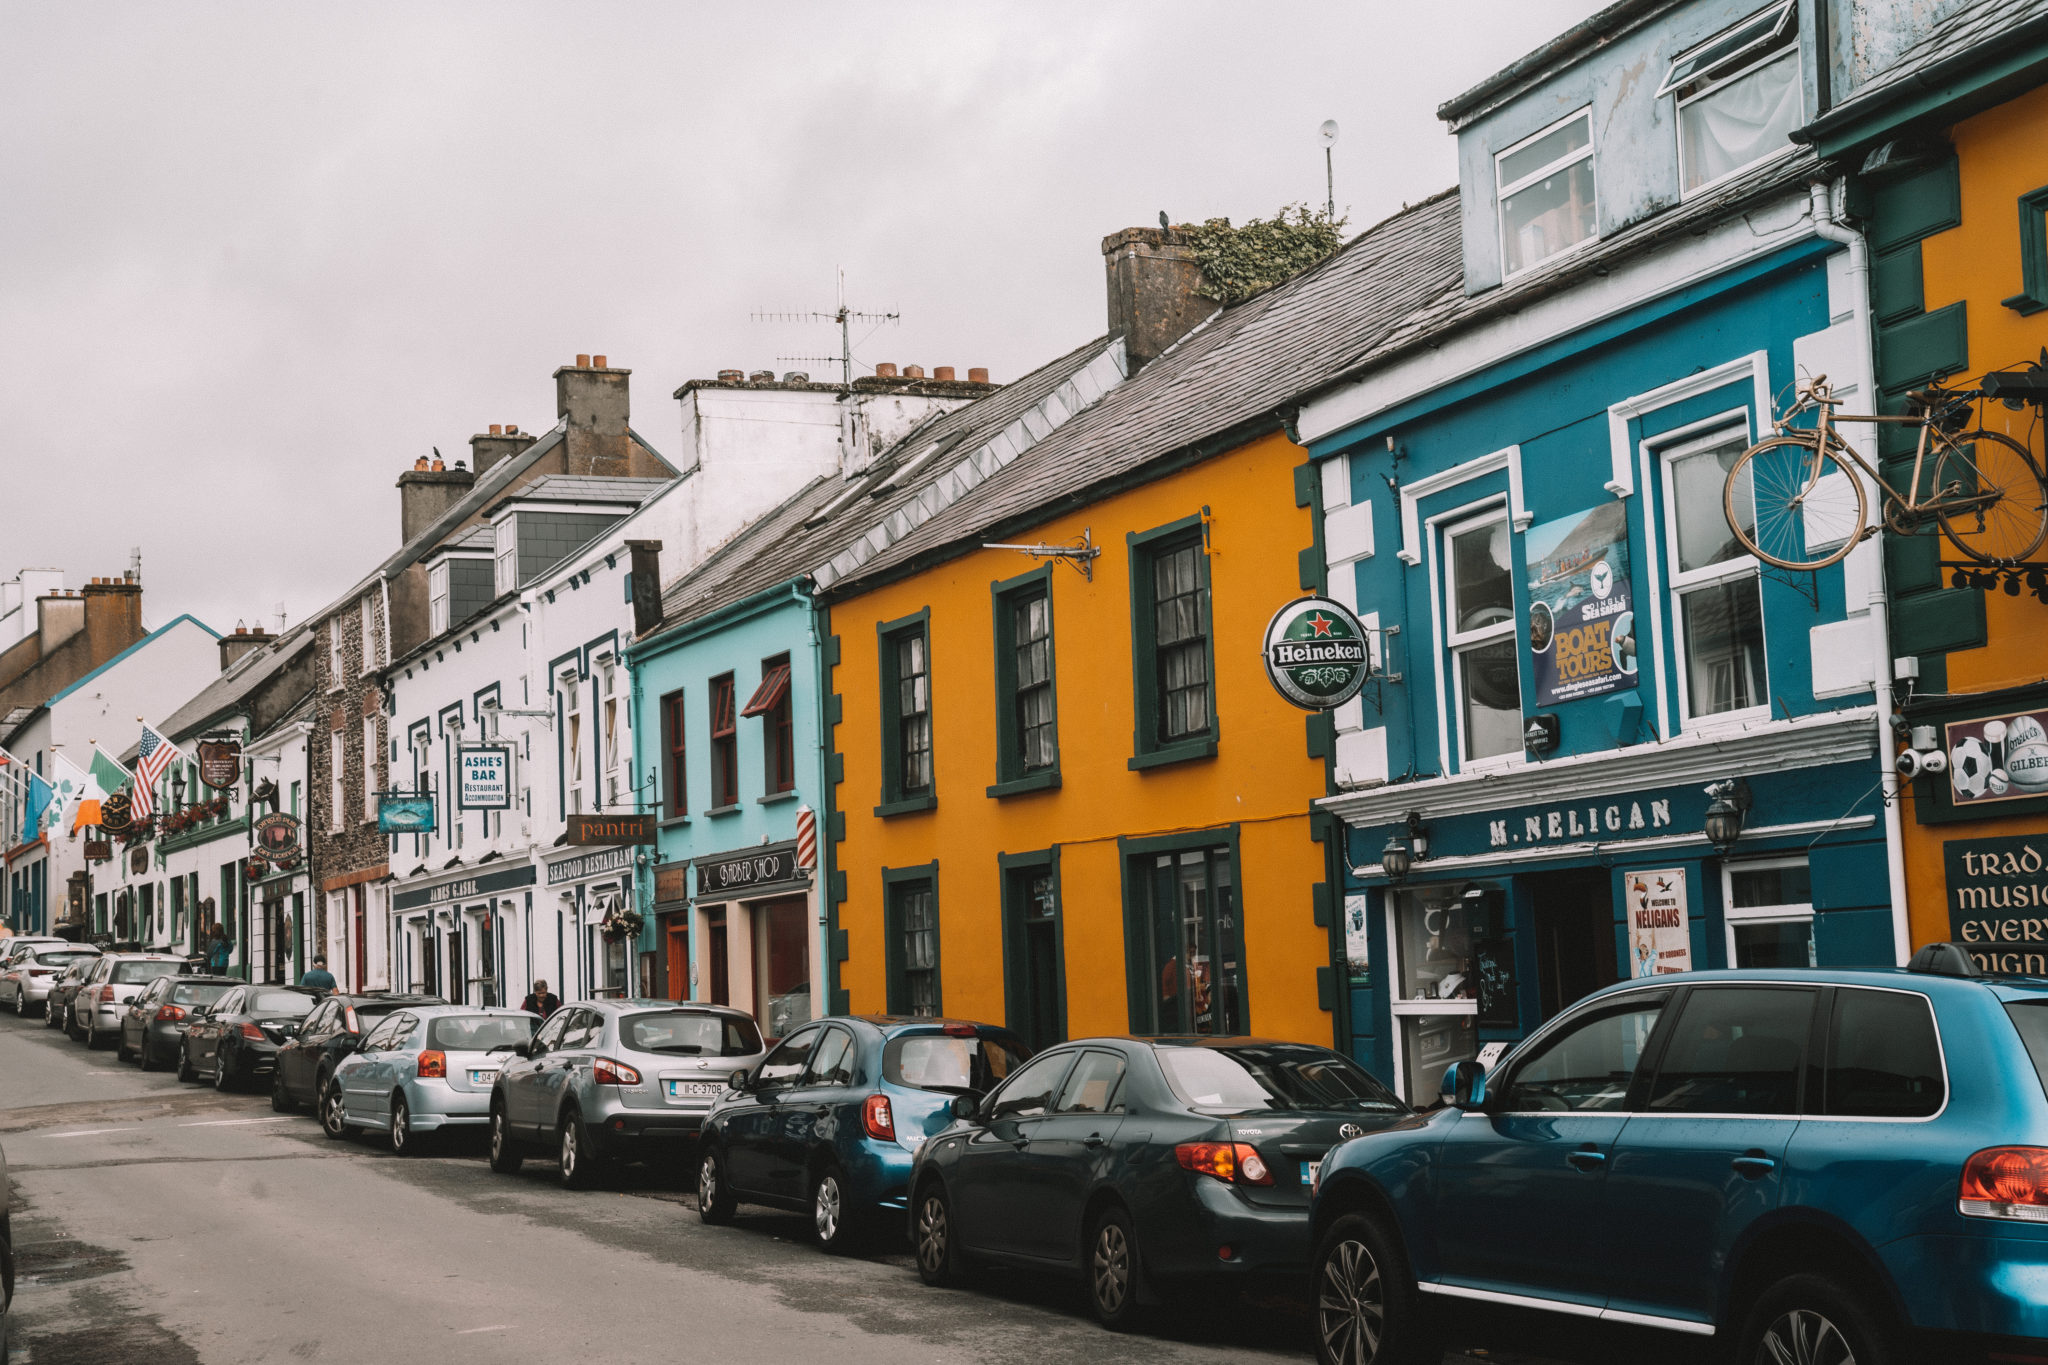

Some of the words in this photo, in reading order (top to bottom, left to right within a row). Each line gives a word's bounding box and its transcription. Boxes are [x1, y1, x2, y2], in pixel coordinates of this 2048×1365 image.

[1554, 620, 1611, 660] BOAT
[1277, 643, 1363, 663] Heineken
[1556, 647, 1613, 680] TOURS
[465, 756, 503, 767] ASHE'S
[472, 770, 496, 780] BAR
[464, 783, 503, 792] RESTAURANT
[581, 818, 644, 841] pantri
[549, 860, 583, 882] SEAFOOD
[719, 861, 752, 887] BARBER
[754, 856, 780, 883] SHOP
[1651, 899, 1670, 907] WELCOME
[1670, 898, 1676, 906] TO
[1635, 908, 1681, 929] NELIGANS
